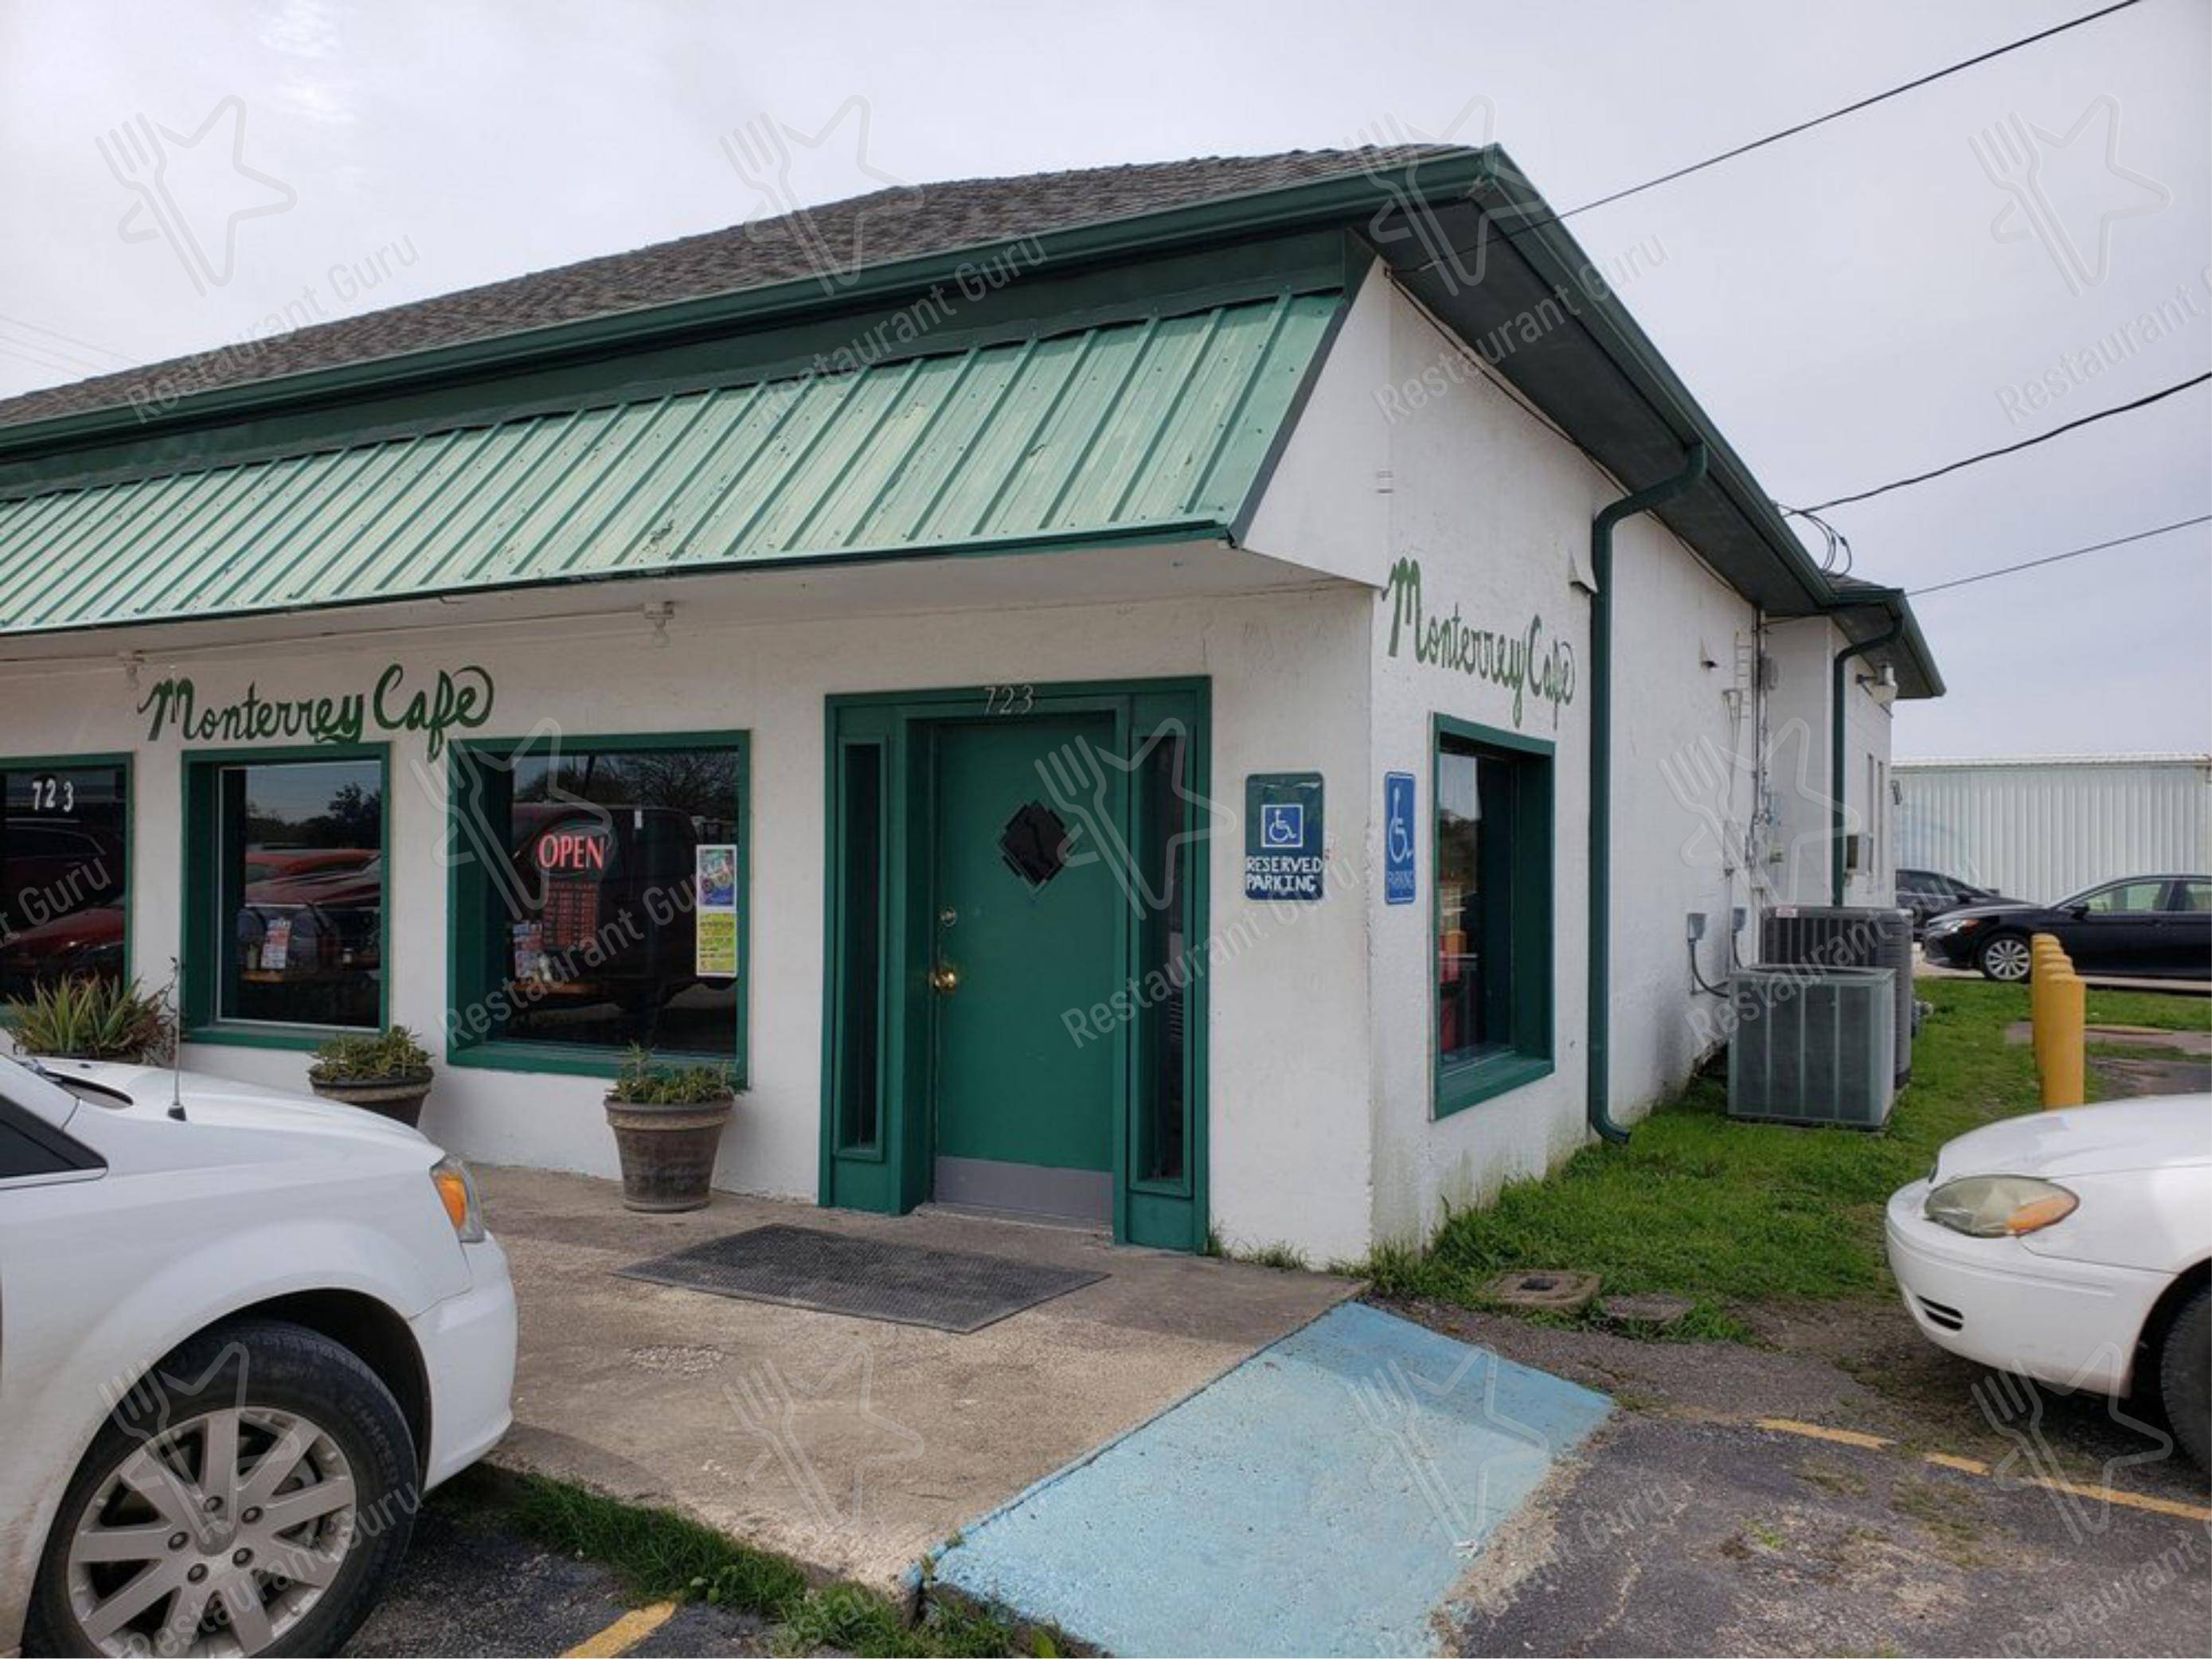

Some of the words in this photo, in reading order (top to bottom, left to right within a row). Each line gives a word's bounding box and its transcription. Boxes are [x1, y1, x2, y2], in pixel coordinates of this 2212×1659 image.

[1381, 556, 1526, 729] Monterrey
[1528, 613, 1575, 731] Cafe
[138, 677, 364, 744] Monterrey
[373, 663, 494, 763] Cafe
[983, 685, 1034, 716] 723
[32, 778, 74, 812] 723
[538, 833, 605, 870] OPEN
[1246, 856, 1323, 873] RESERVED
[1247, 874, 1316, 892] PARKING
